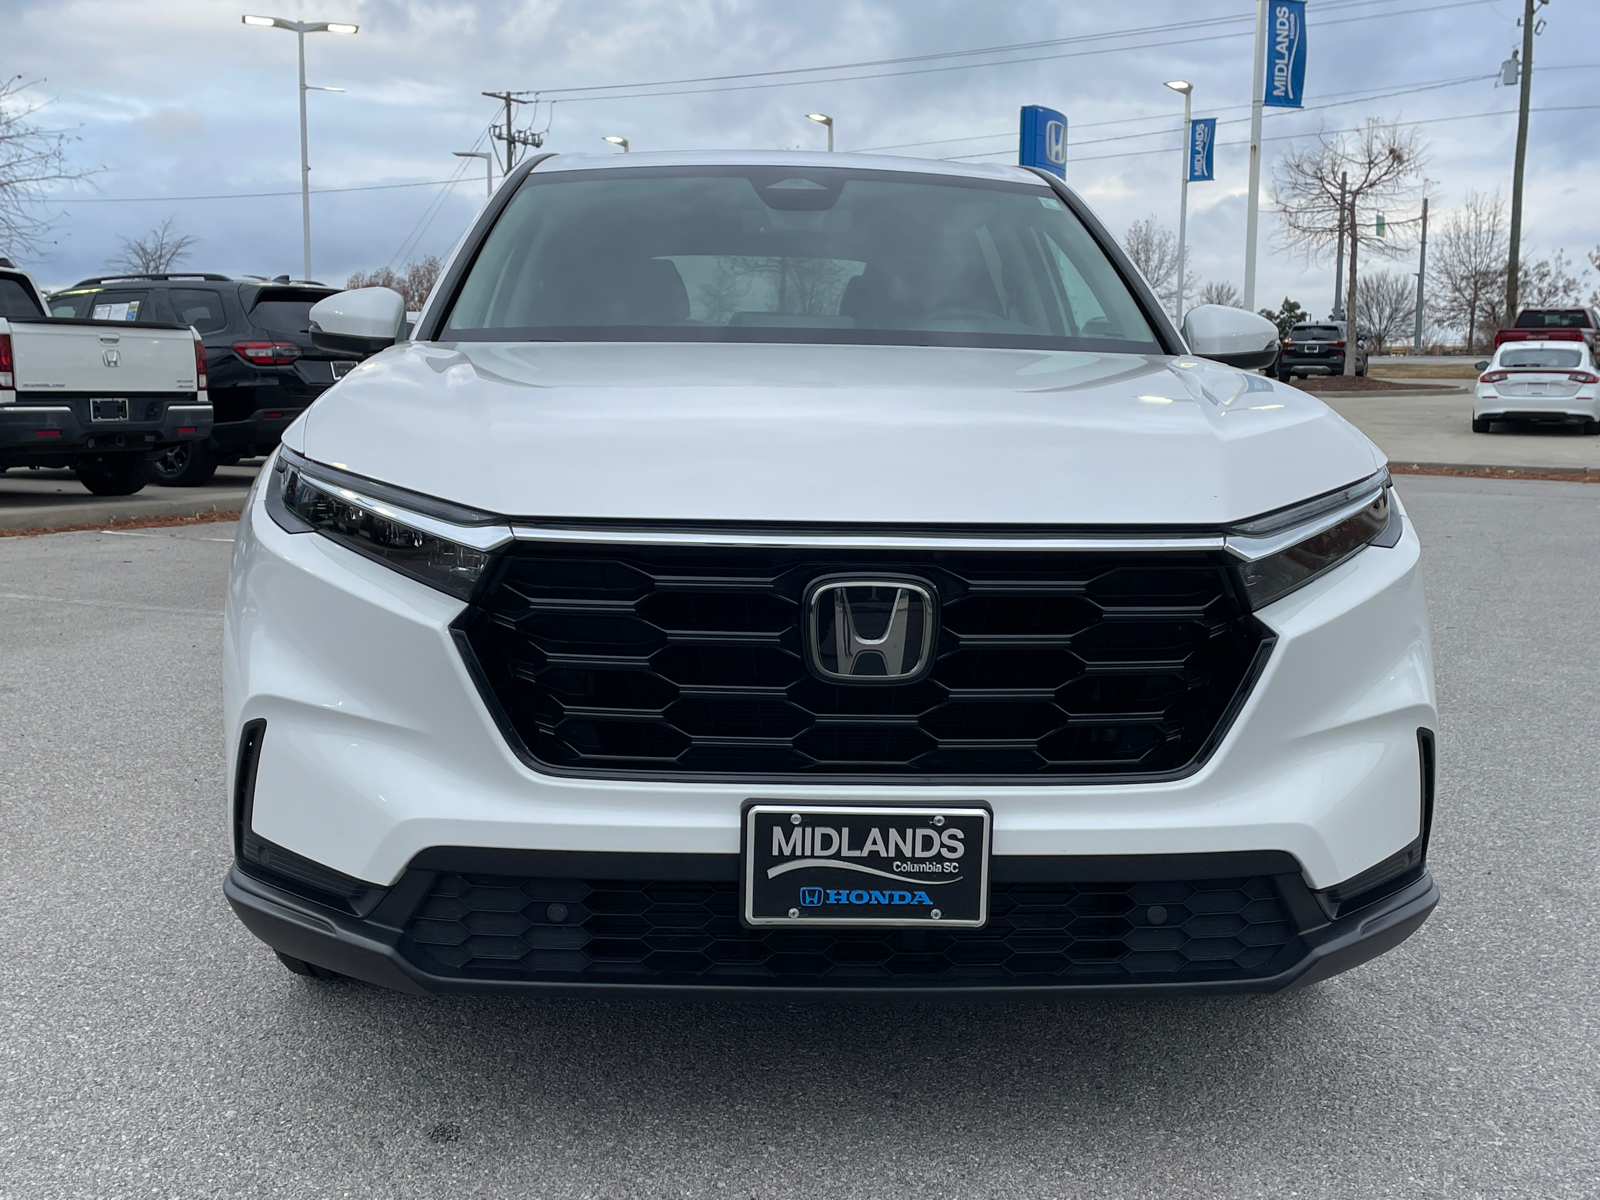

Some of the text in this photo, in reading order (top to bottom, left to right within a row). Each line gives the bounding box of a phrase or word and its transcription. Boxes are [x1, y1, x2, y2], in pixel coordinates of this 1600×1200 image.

[1272, 6, 1289, 96] MIDLANDS
[1194, 123, 1204, 176] MIDLANDS
[772, 826, 965, 859] MIDLANDS
[893, 861, 959, 873] Columbia SC
[826, 889, 933, 905] HONDA
